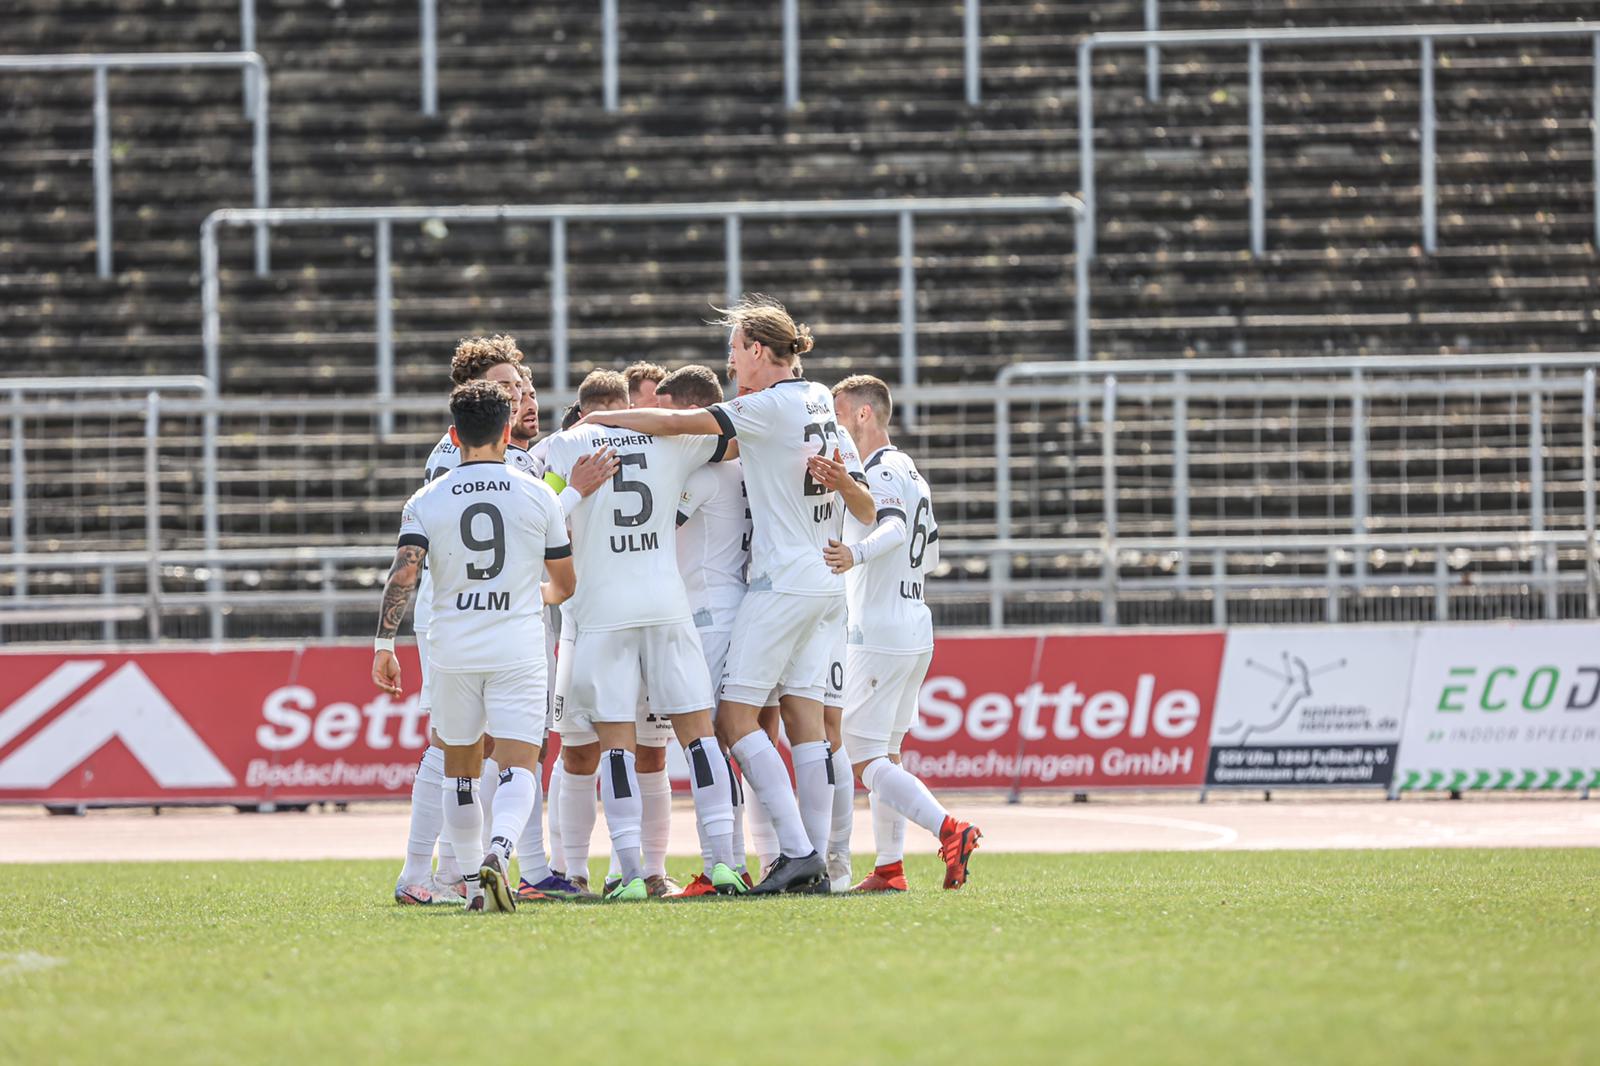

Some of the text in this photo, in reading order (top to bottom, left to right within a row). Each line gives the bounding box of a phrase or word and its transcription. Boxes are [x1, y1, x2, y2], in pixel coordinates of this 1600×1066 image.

[592, 434, 654, 448] REICHERT
[451, 480, 511, 495] COBAN
[613, 452, 654, 528] 5
[460, 501, 507, 580] 9
[610, 531, 660, 554] ULM
[909, 496, 929, 569] 6
[455, 591, 511, 611] ULM
[256, 685, 431, 750] Sett
[909, 673, 1201, 742] Settele
[901, 750, 1094, 781] Bedachungen
[1101, 747, 1194, 776] GmbH
